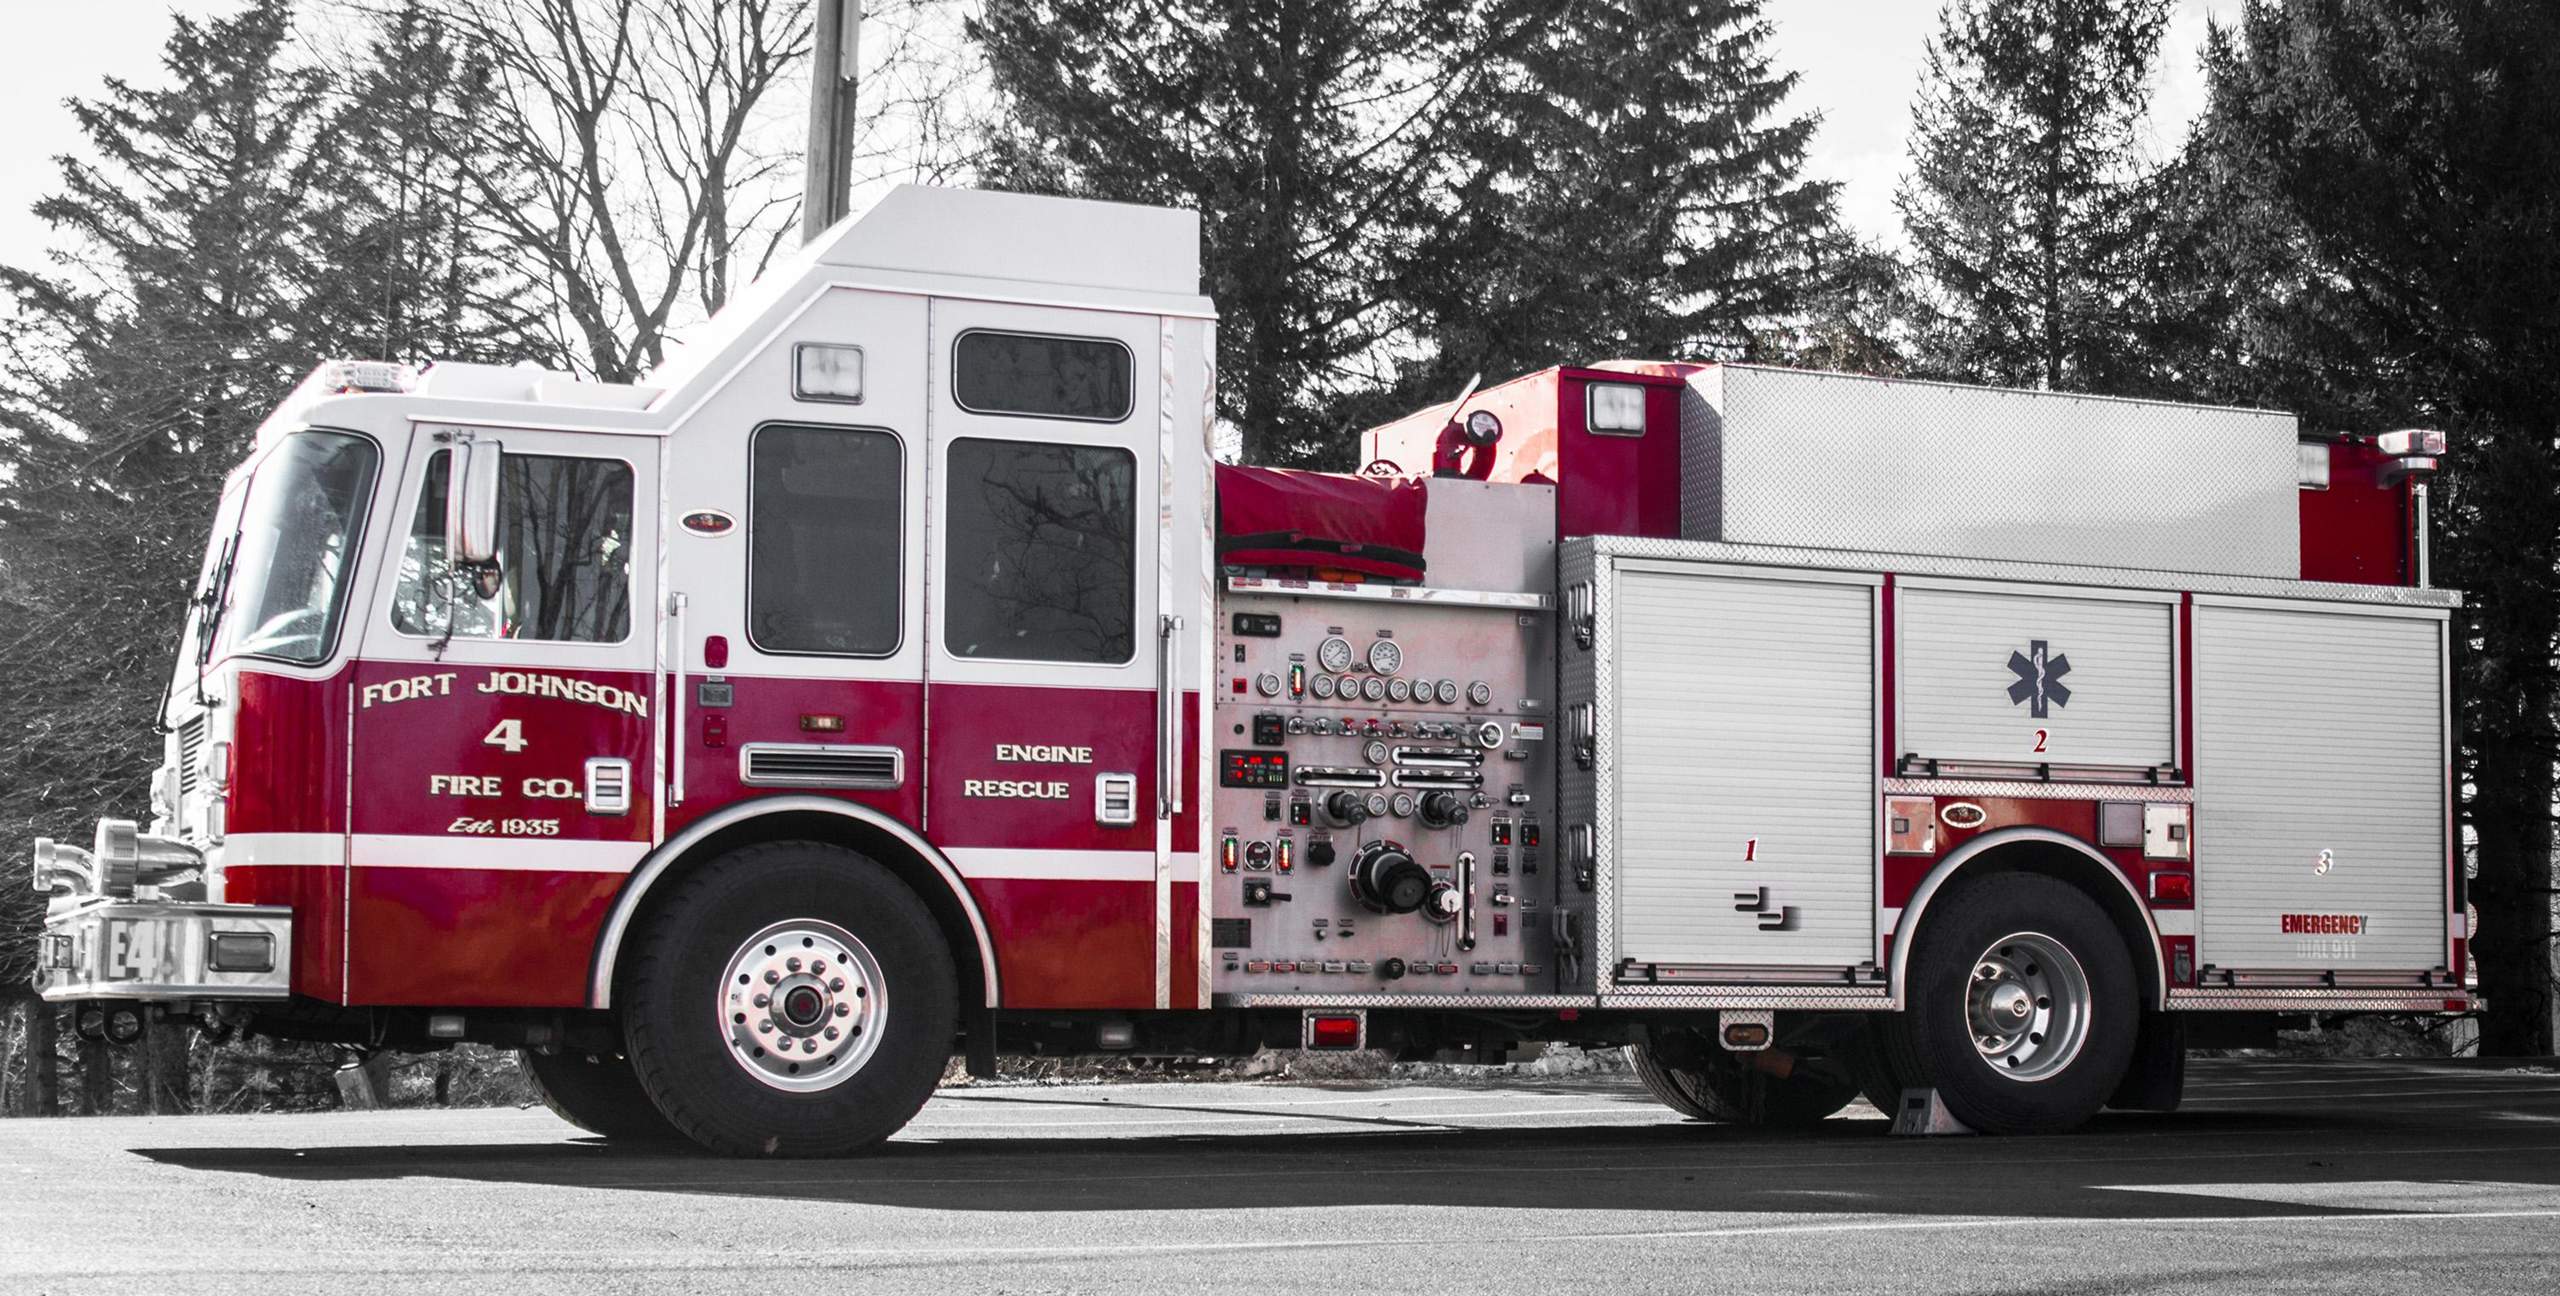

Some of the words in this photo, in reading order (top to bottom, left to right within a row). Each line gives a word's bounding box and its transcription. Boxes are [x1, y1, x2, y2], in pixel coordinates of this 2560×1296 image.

[362, 673, 457, 709] FORT
[477, 671, 648, 718] JOHNSON
[484, 718, 528, 752] 4
[2033, 728, 2048, 753] 2
[995, 744, 1093, 763] ENGINE
[430, 774, 502, 797] FIRE
[522, 777, 583, 799] CO.
[964, 779, 1070, 799] RESCUE
[447, 816, 496, 834] Est.
[501, 818, 560, 836] 1935
[1744, 838, 1758, 862] 1
[2314, 848, 2334, 877] 3
[2281, 914, 2368, 934] EMERGENCY
[109, 921, 157, 977] E4
[2296, 939, 2328, 959] DIAL
[2331, 939, 2356, 959] 911
